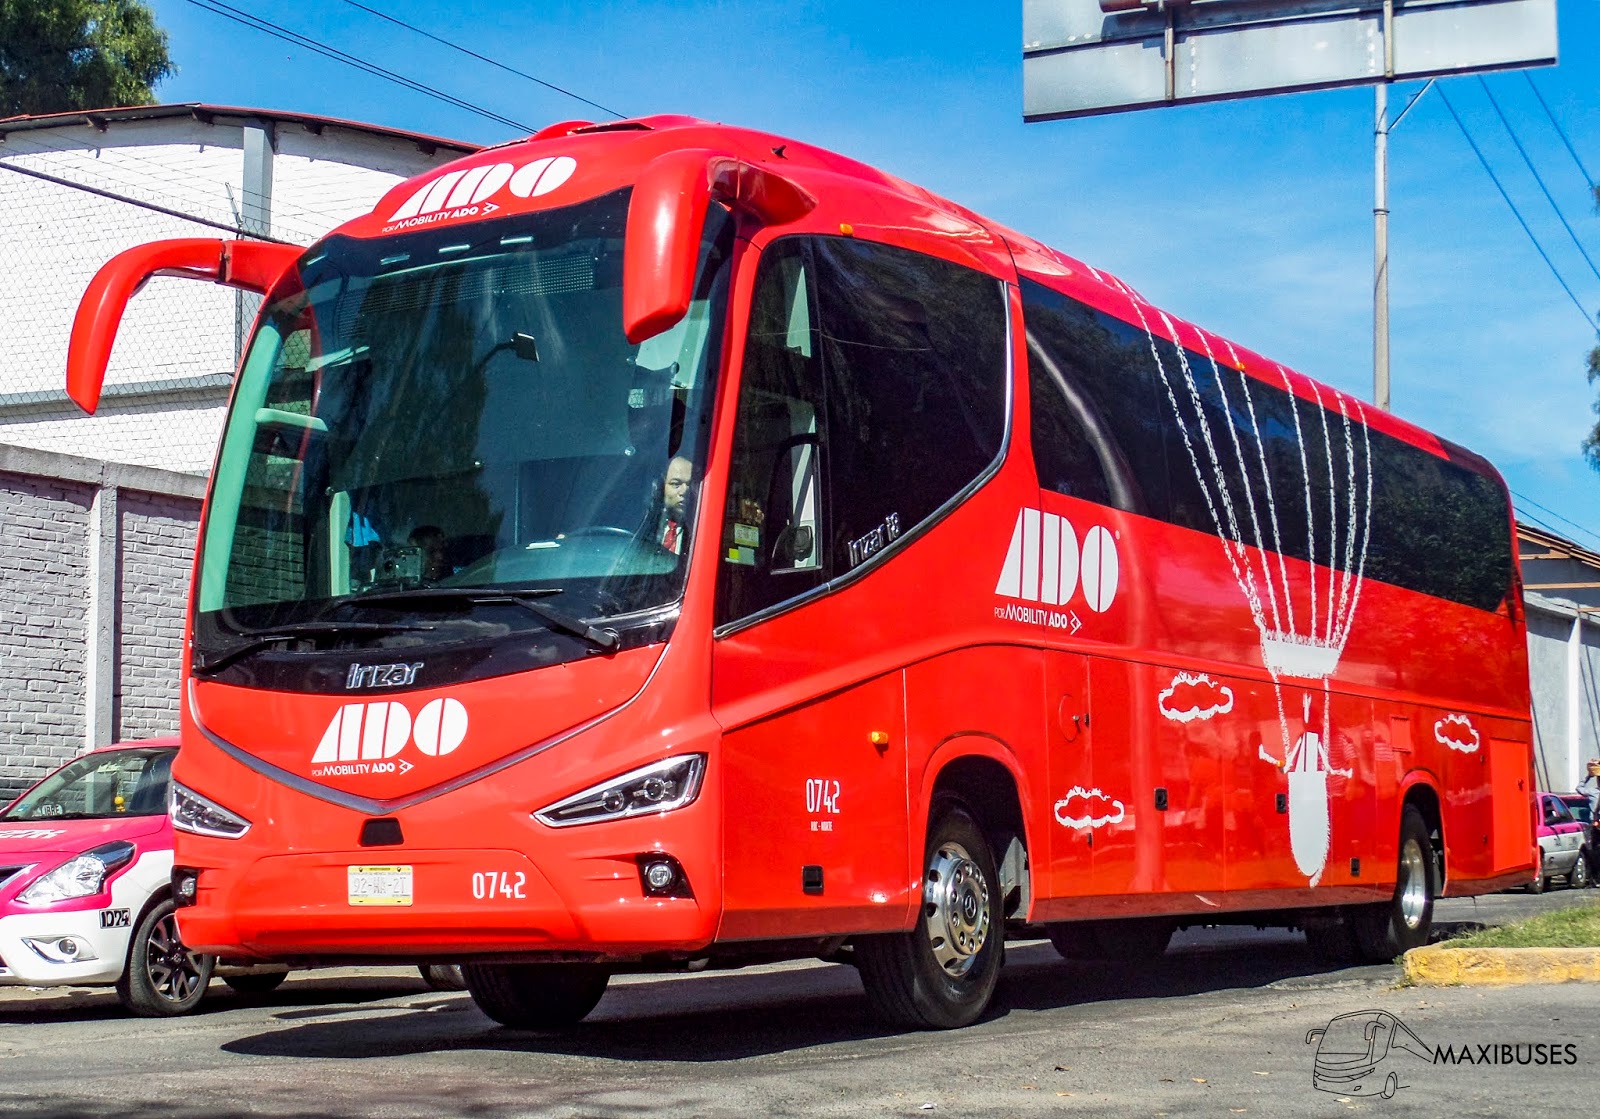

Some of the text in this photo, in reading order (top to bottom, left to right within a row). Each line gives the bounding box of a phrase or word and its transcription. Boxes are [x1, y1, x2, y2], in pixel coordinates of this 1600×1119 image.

[387, 156, 577, 222] ADO
[394, 211, 452, 230] MOBILITY
[451, 206, 479, 218] ADO
[994, 507, 1119, 613] ADO
[1005, 603, 1047, 626] MOBILITY
[1048, 610, 1068, 629] ADO
[311, 697, 469, 763] ADO
[323, 763, 370, 776] MOBILITY
[372, 763, 396, 774] ADO
[806, 778, 840, 814] 0742
[472, 872, 526, 899] 0742
